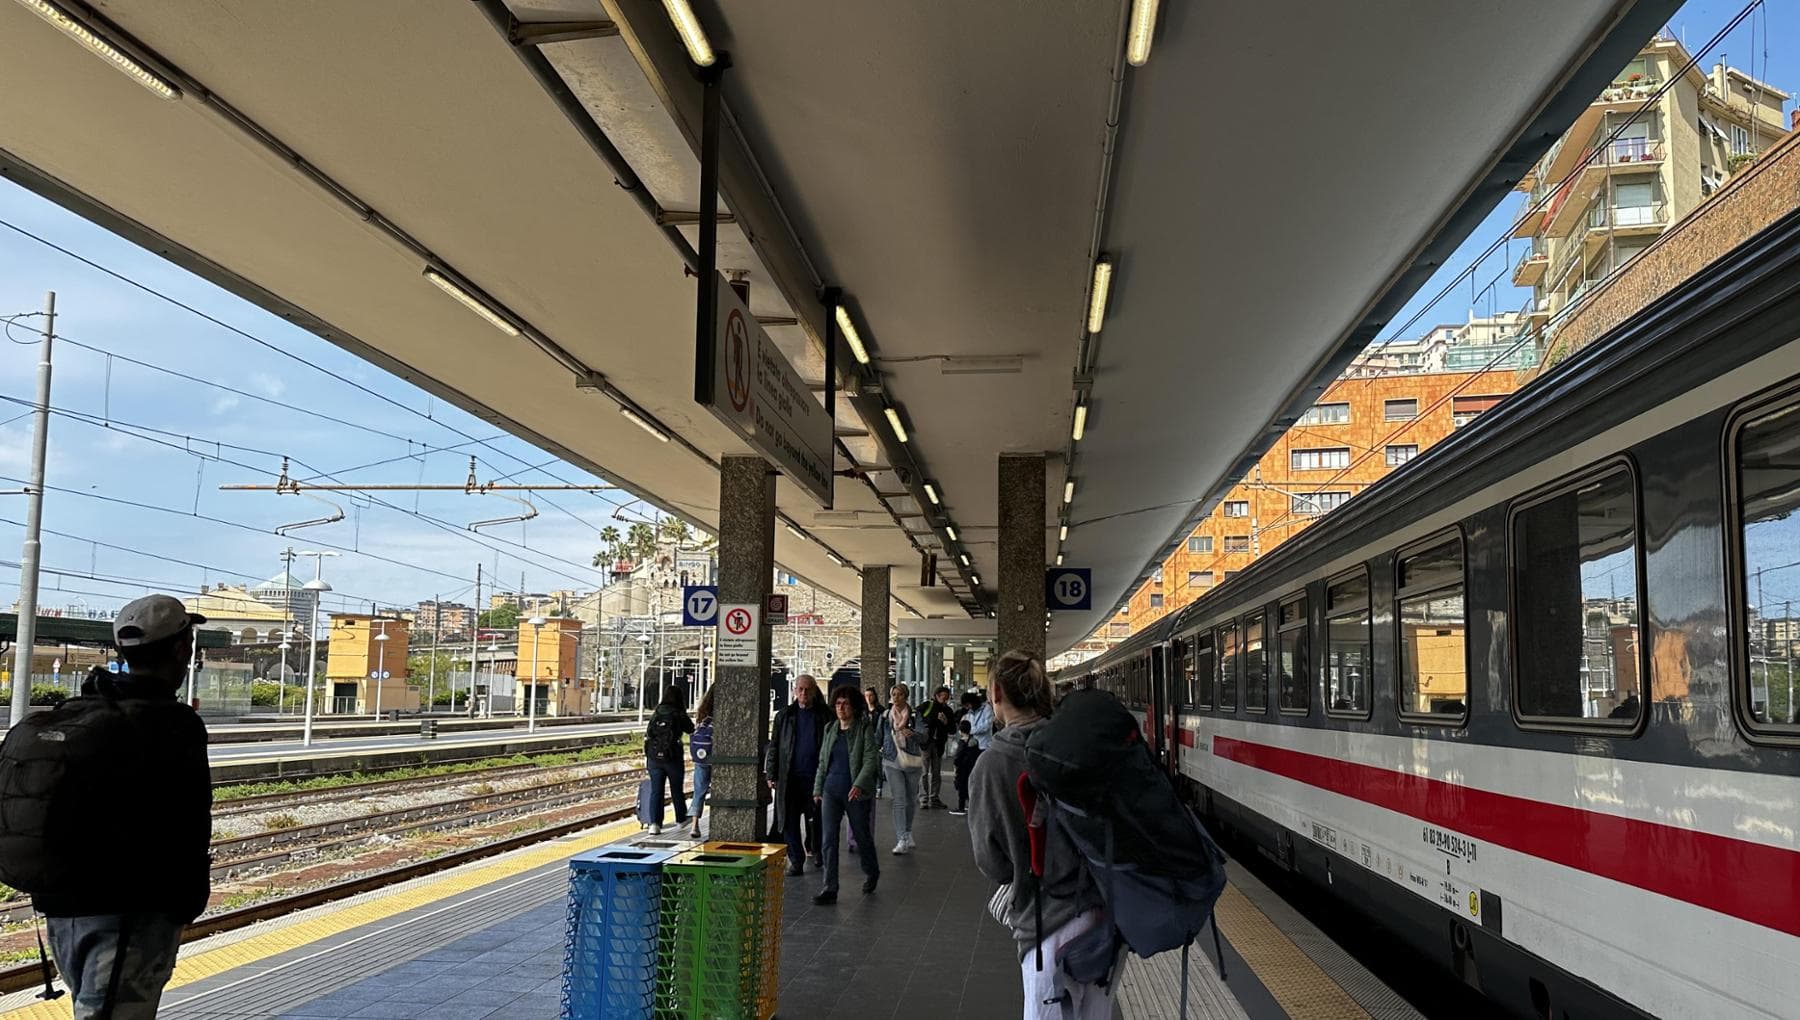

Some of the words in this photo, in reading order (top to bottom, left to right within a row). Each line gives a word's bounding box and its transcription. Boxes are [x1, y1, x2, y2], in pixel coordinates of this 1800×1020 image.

[762, 346, 781, 383] vietato
[757, 362, 762, 385] la
[764, 371, 777, 400] linea
[778, 389, 792, 418] gialla
[756, 404, 764, 429] Do
[765, 418, 773, 437] not
[775, 432, 782, 449] go
[783, 432, 800, 465] beyond
[692, 598, 714, 613] 17
[1059, 581, 1082, 598] 18
[1423, 827, 1428, 843] 61
[1429, 828, 1436, 845] 83
[1436, 830, 1450, 850] 29-90
[1451, 835, 1466, 856] 524-3
